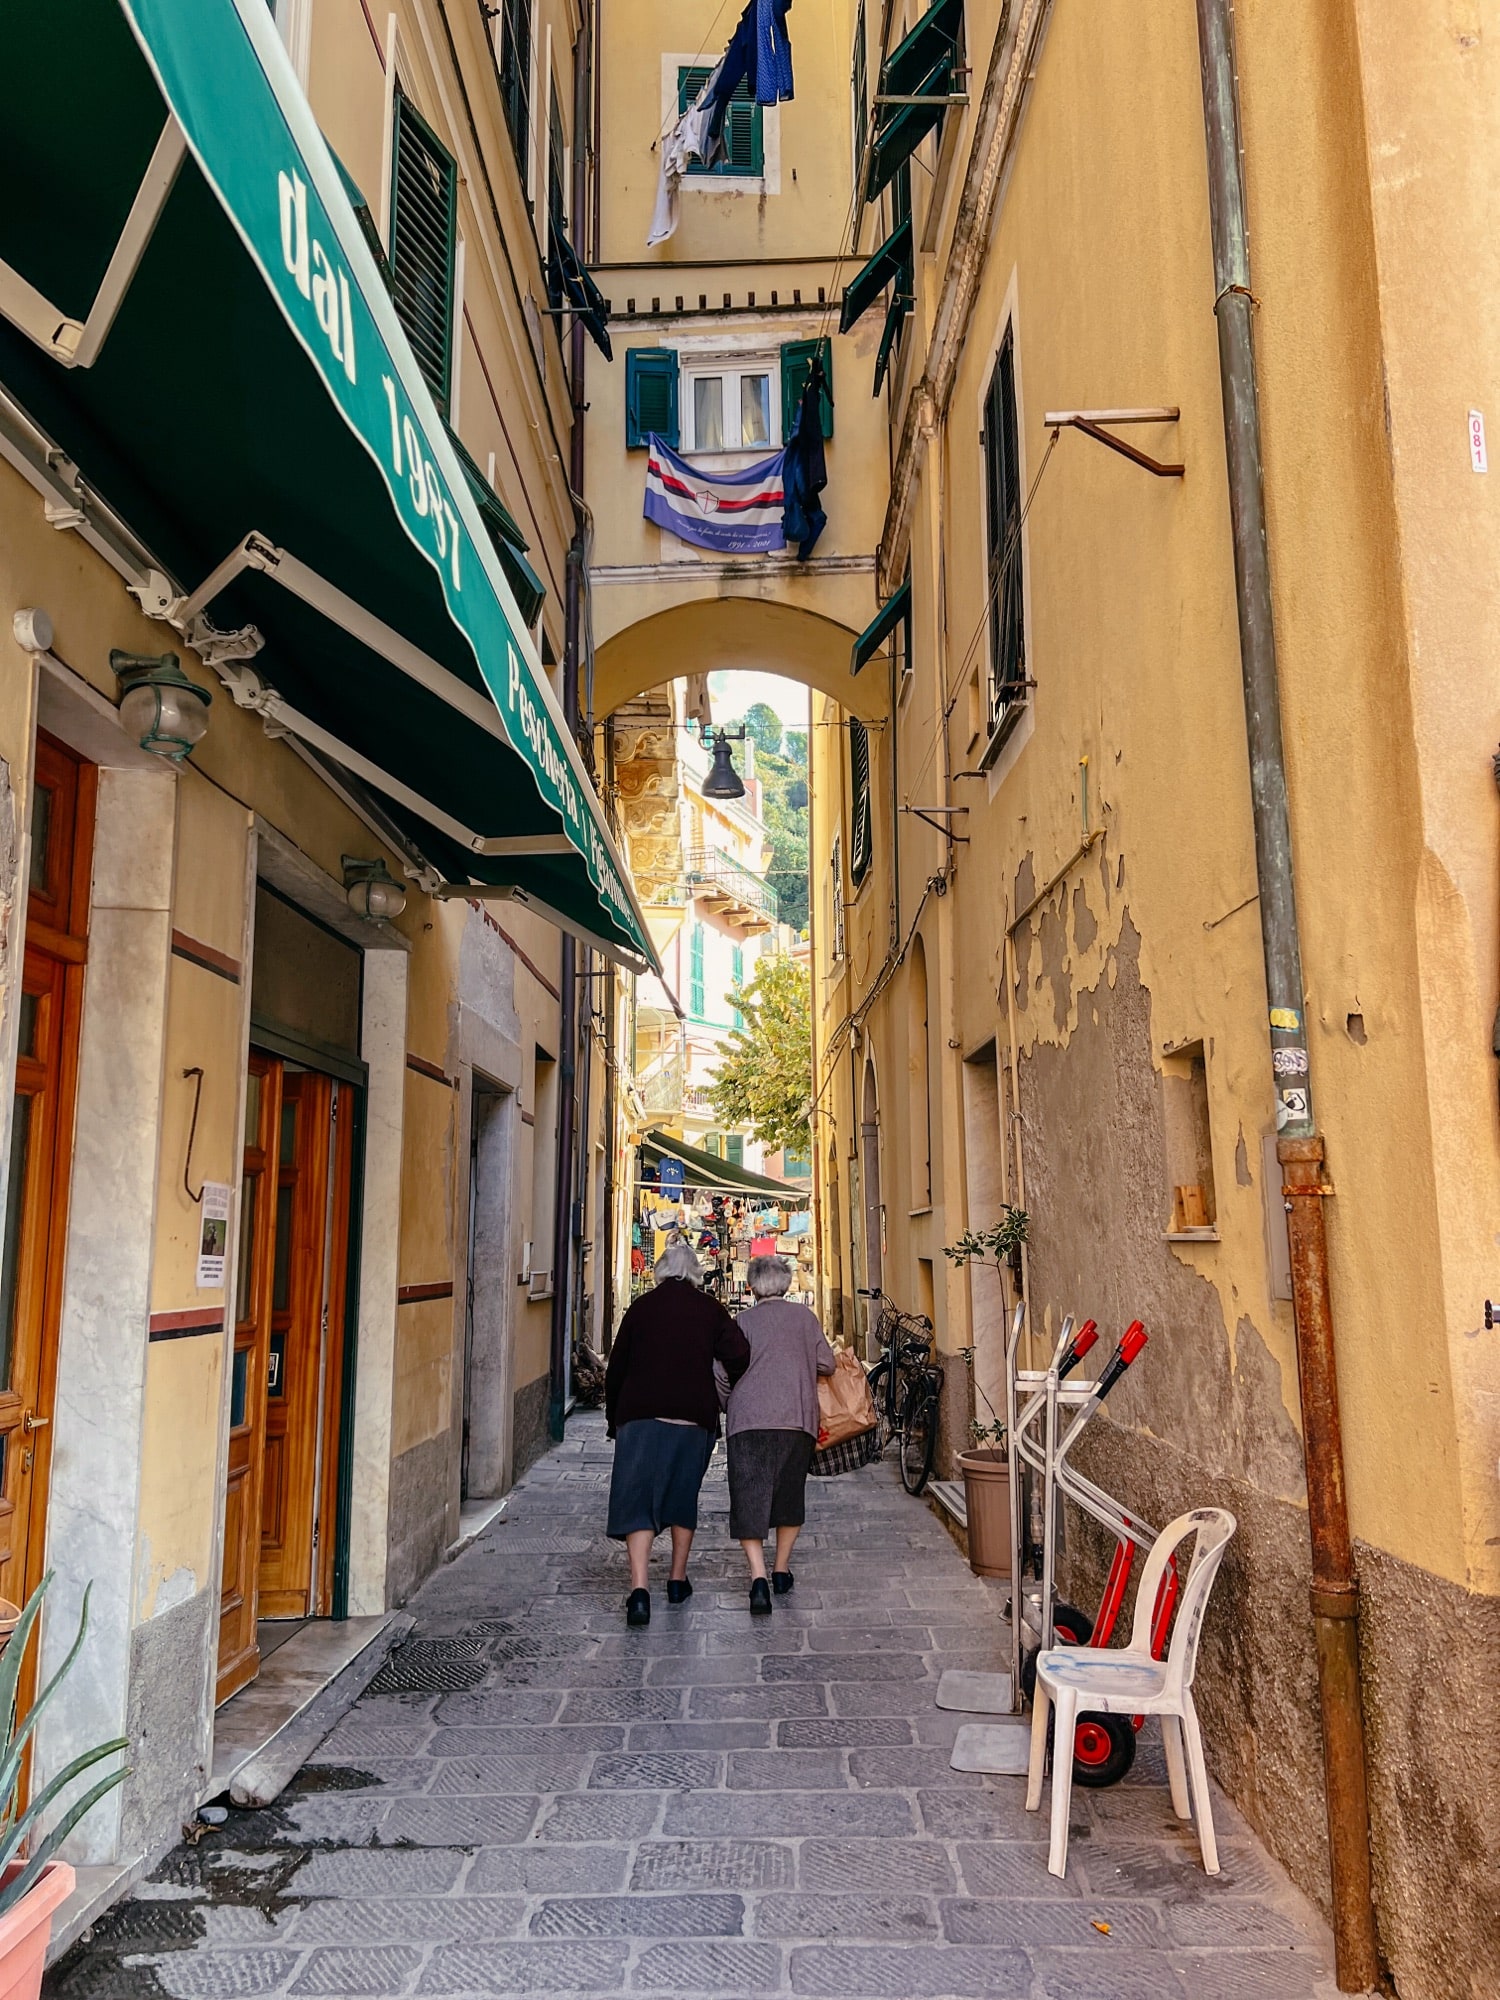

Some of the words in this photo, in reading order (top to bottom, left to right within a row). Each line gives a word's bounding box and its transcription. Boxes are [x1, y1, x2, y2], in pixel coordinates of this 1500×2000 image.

[278, 167, 356, 386] dal
[382, 373, 462, 592] 1987
[506, 639, 580, 829] Pescheria
